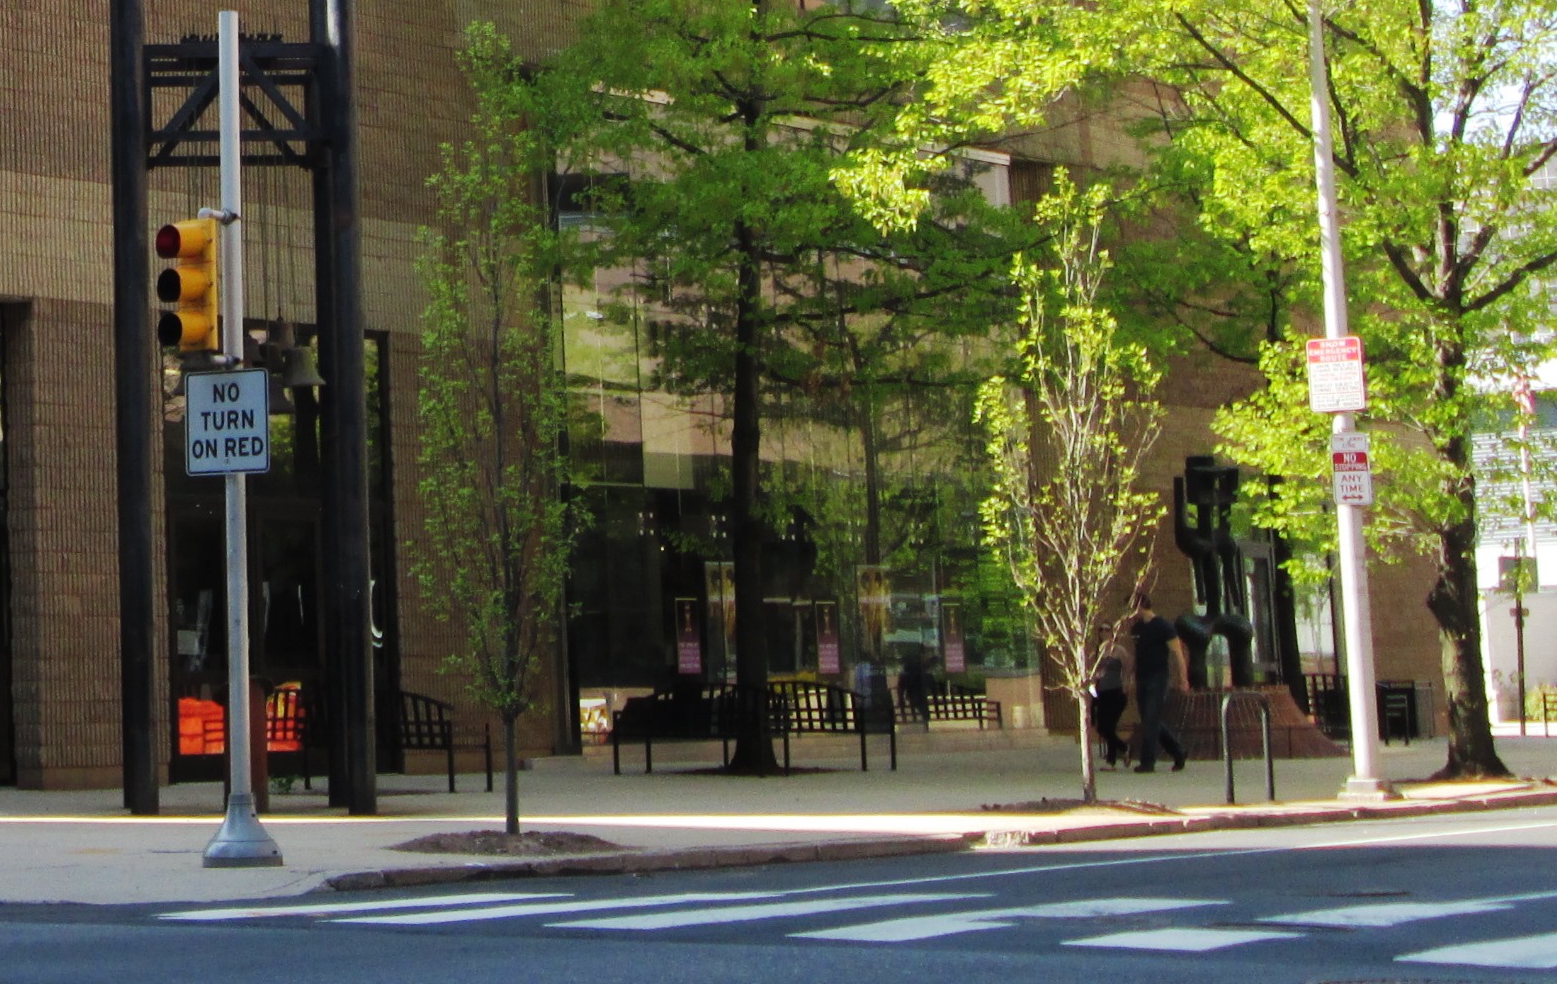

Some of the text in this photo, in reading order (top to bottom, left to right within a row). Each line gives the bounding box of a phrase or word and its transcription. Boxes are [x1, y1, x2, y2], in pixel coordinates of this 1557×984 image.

[1319, 341, 1346, 349] SNOW
[1309, 347, 1357, 355] EMERGENCY
[1319, 354, 1348, 363] ROUTE
[213, 382, 239, 403] NO
[201, 409, 254, 431] TURN
[192, 436, 264, 459] ON RED
[1343, 453, 1356, 463] NO
[1341, 475, 1362, 483] ANY
